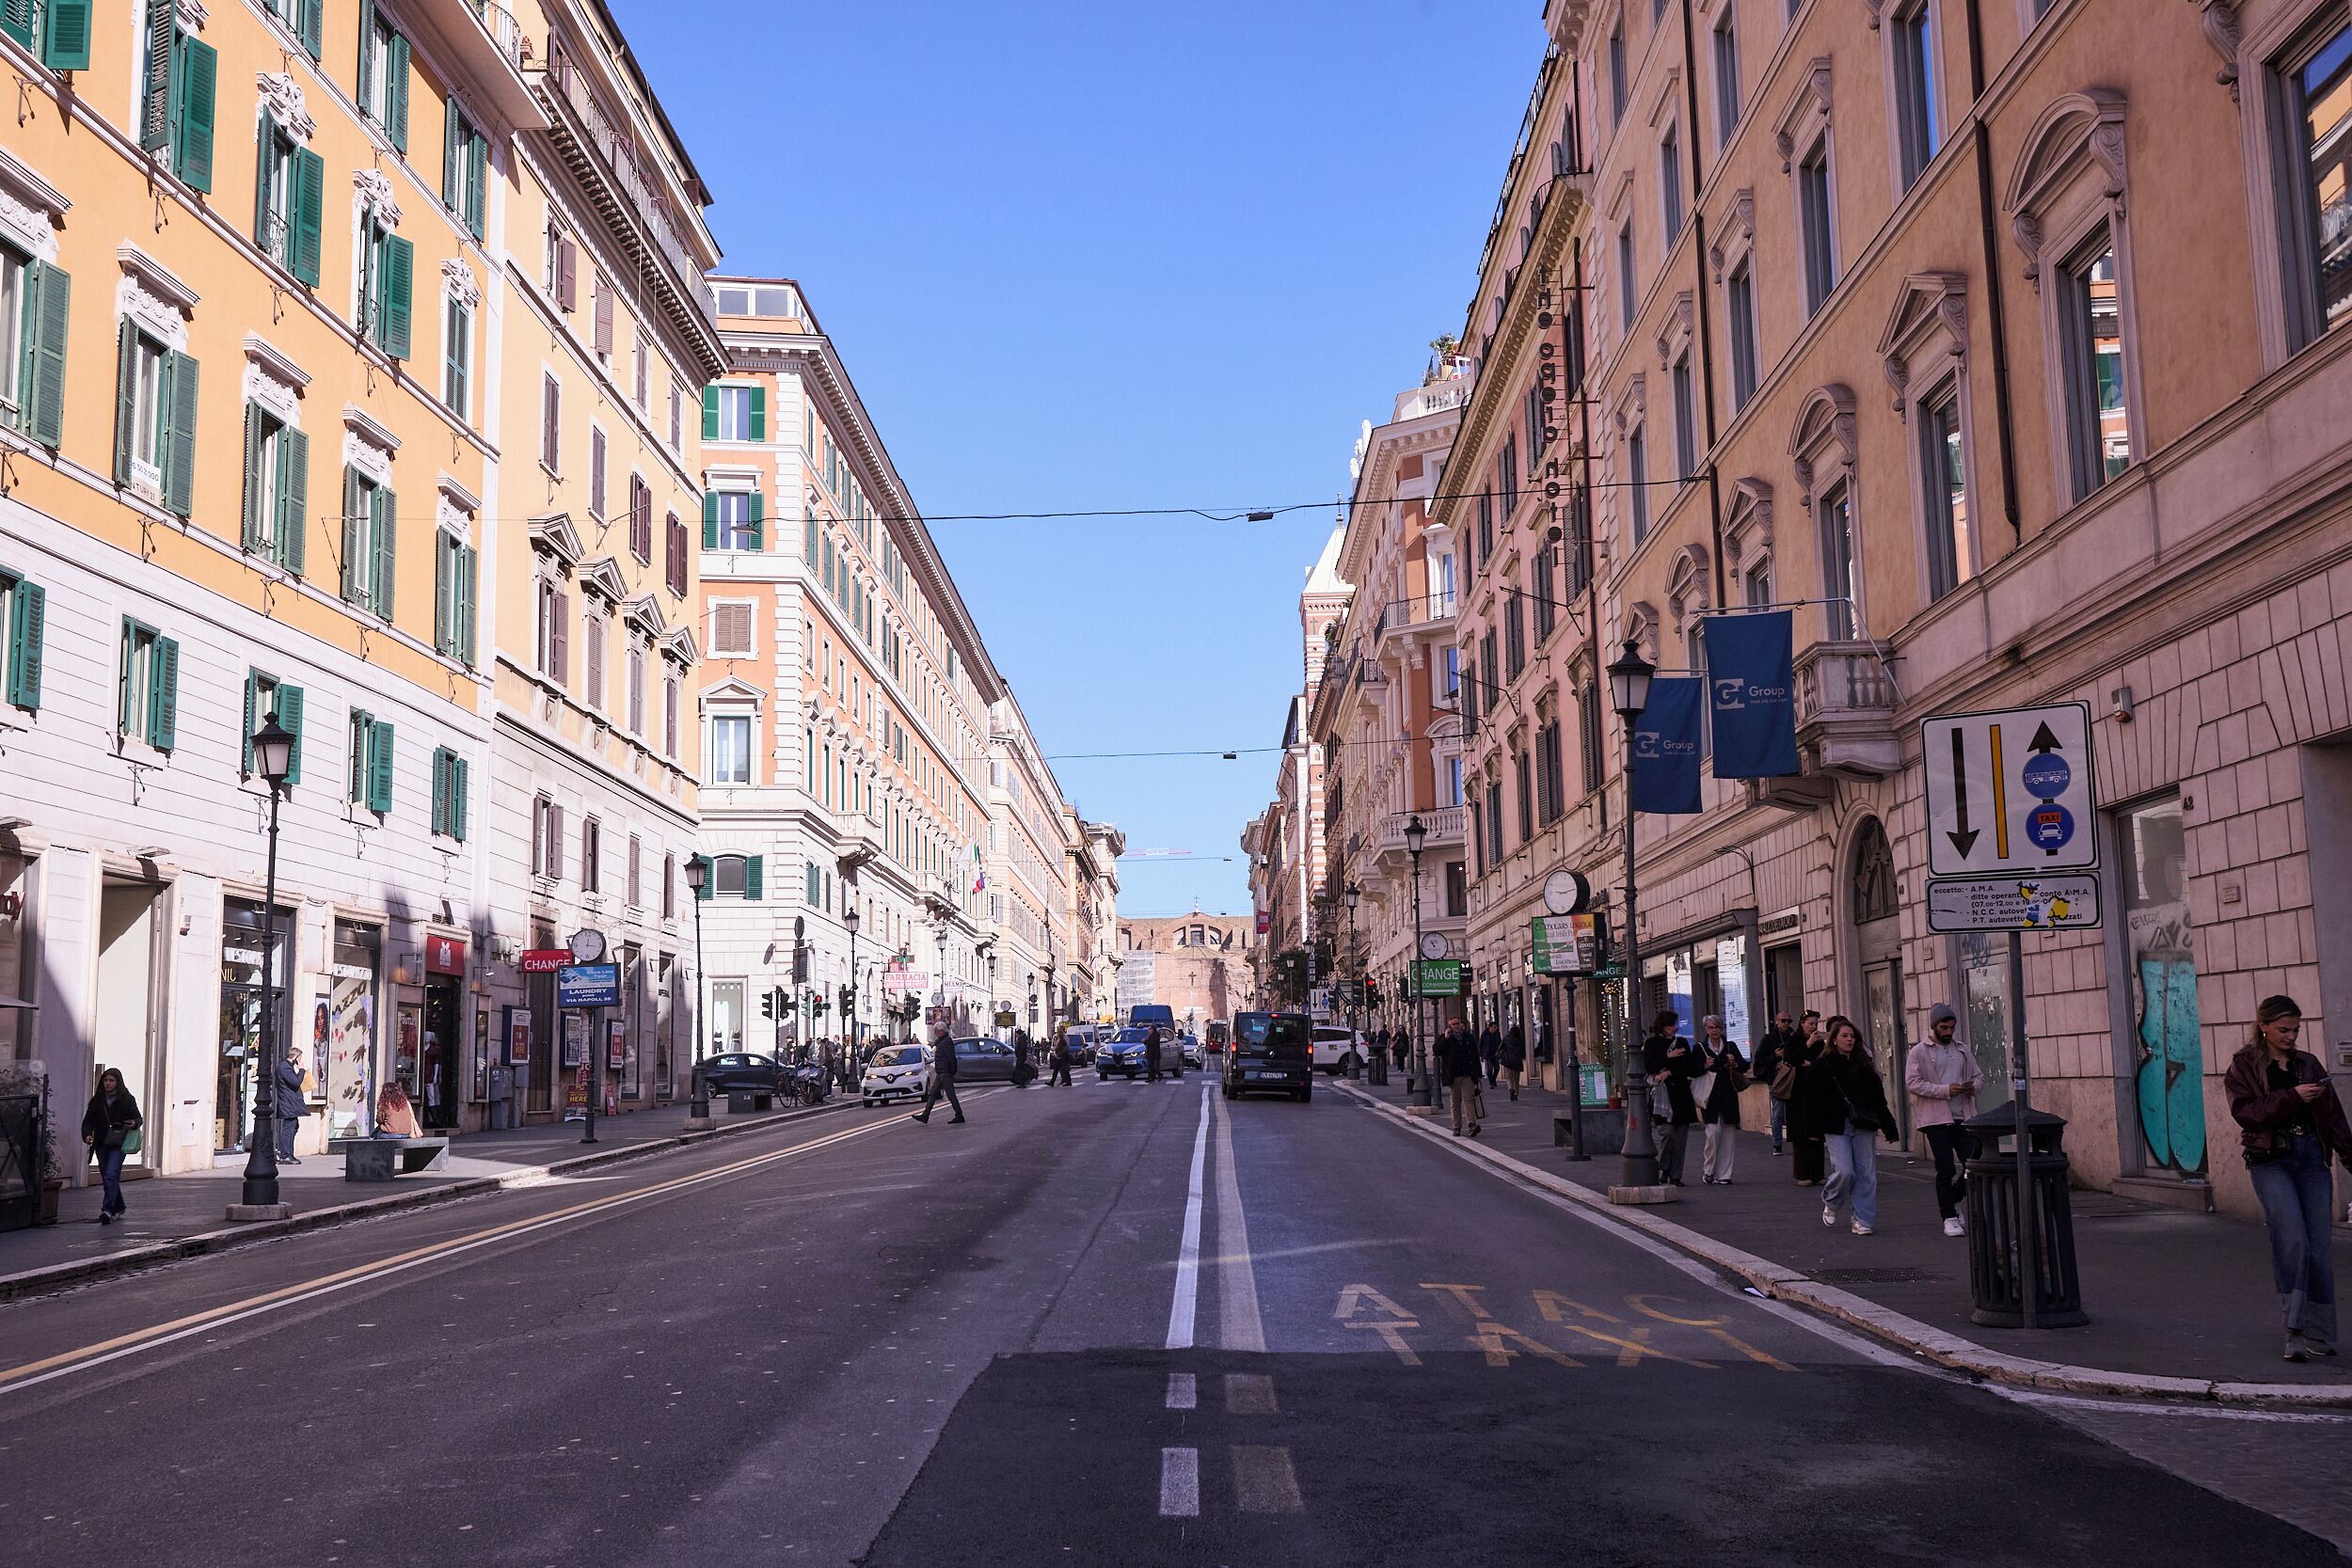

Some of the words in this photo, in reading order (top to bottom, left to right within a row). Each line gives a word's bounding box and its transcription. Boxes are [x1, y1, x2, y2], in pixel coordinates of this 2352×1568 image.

[1749, 686, 1785, 698] Group
[1663, 739, 1693, 752] Group
[2183, 796, 2194, 811] 42
[2041, 814, 2059, 822] TAXI
[1934, 886, 1964, 895] eccetto:
[1411, 968, 1459, 980] CHANGE
